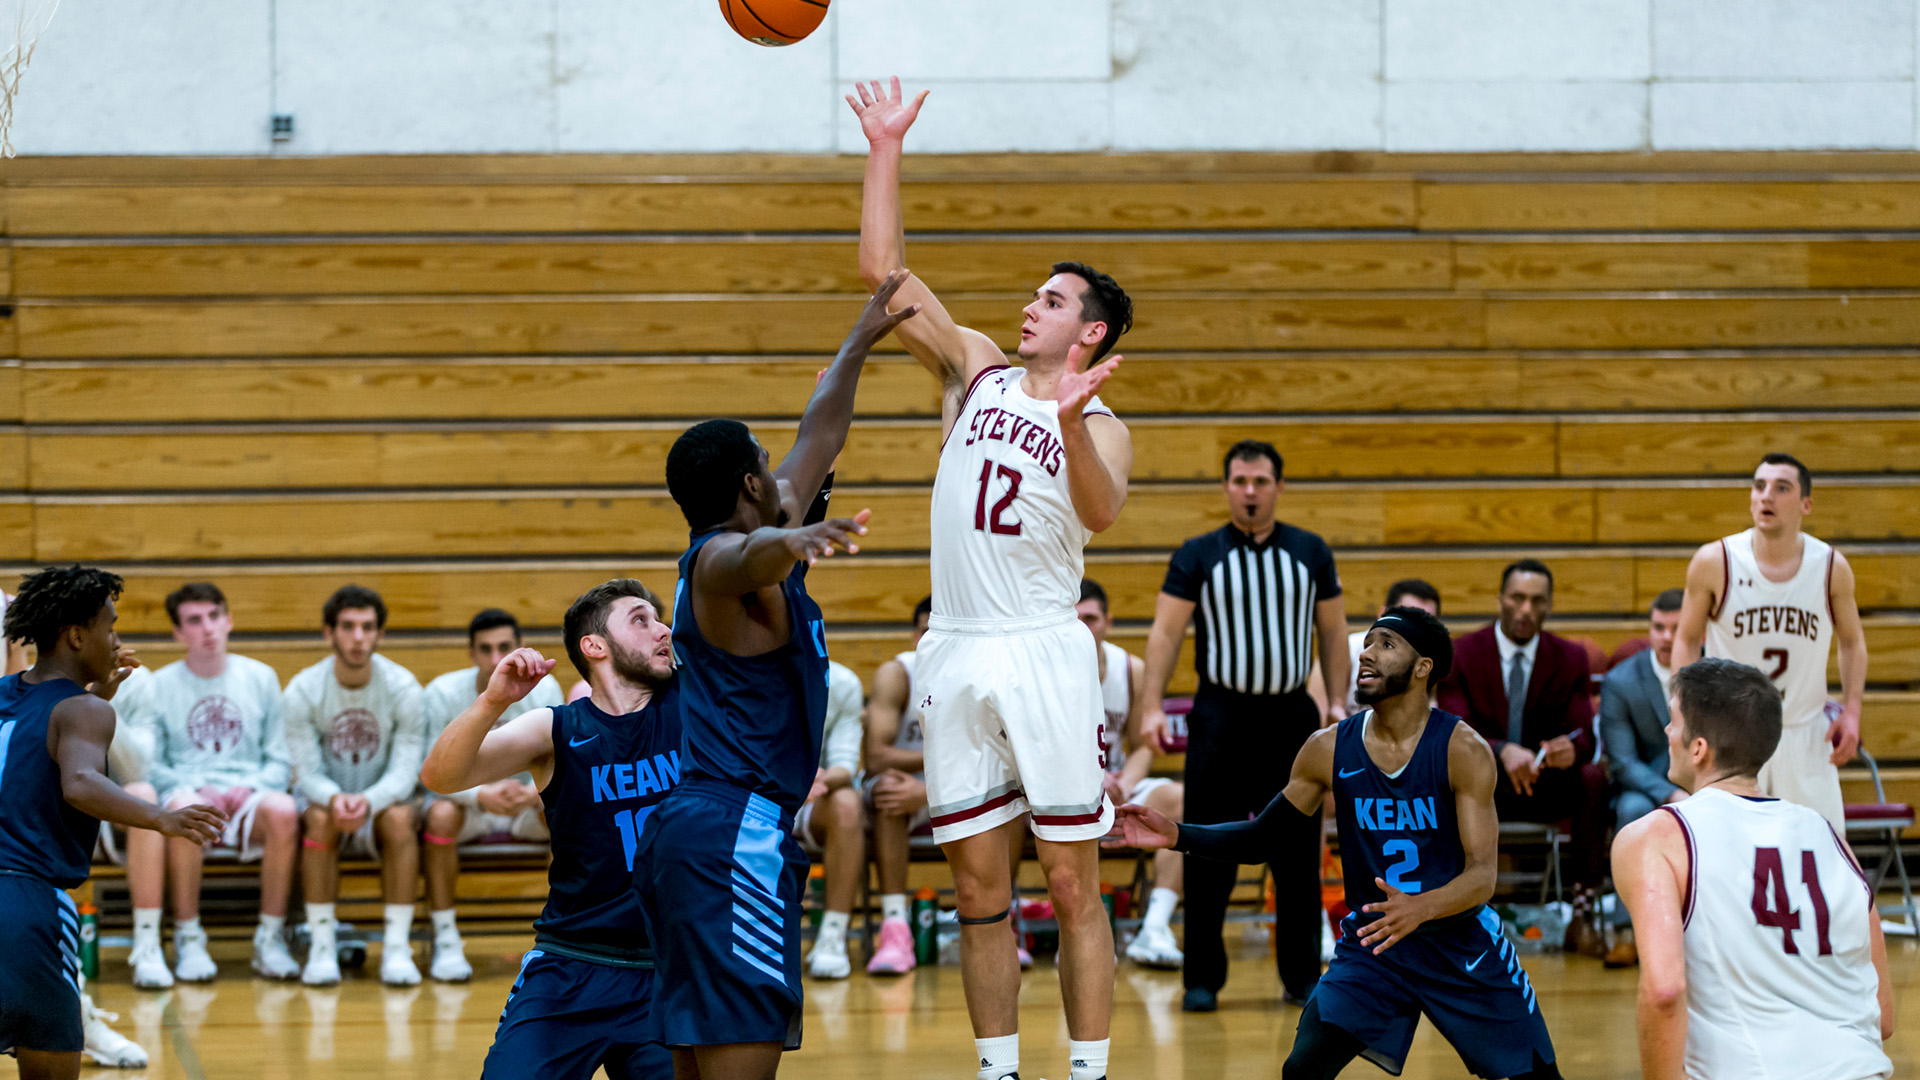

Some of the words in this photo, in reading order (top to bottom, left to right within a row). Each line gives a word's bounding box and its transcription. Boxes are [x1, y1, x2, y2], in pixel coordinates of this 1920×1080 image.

[966, 407, 1065, 477] STEVENS
[974, 457, 1022, 536] 12
[1734, 606, 1819, 642] STEVENS
[591, 750, 681, 803] KEAN
[1354, 796, 1438, 831] KEAN
[1382, 839, 1421, 894] 2
[1750, 847, 1833, 956] 41
